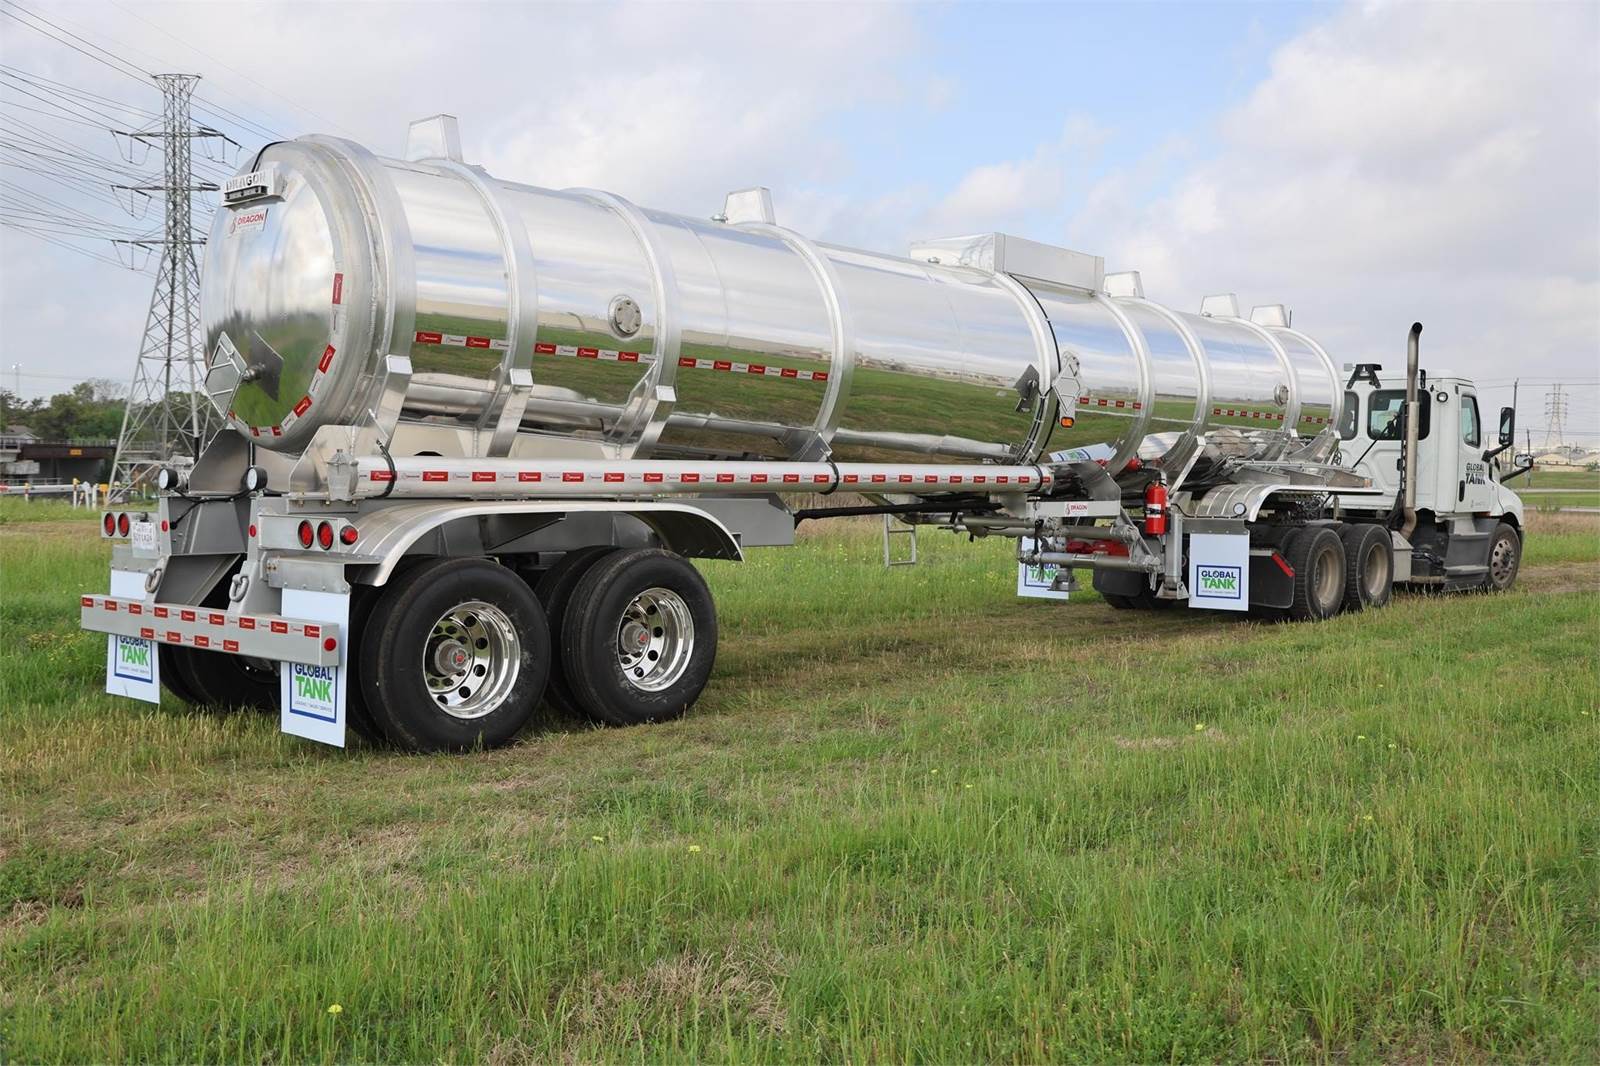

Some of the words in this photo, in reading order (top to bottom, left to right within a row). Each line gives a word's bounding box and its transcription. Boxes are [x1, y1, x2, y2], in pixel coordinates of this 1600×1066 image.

[237, 213, 265, 225] DRAGON
[1466, 462, 1484, 471] GLOBAL
[1201, 570, 1237, 579] GLOBAL
[1201, 577, 1236, 590] TANK
[120, 644, 149, 667] TANK
[295, 663, 333, 681] GLOBAL
[295, 675, 333, 704] TANK
